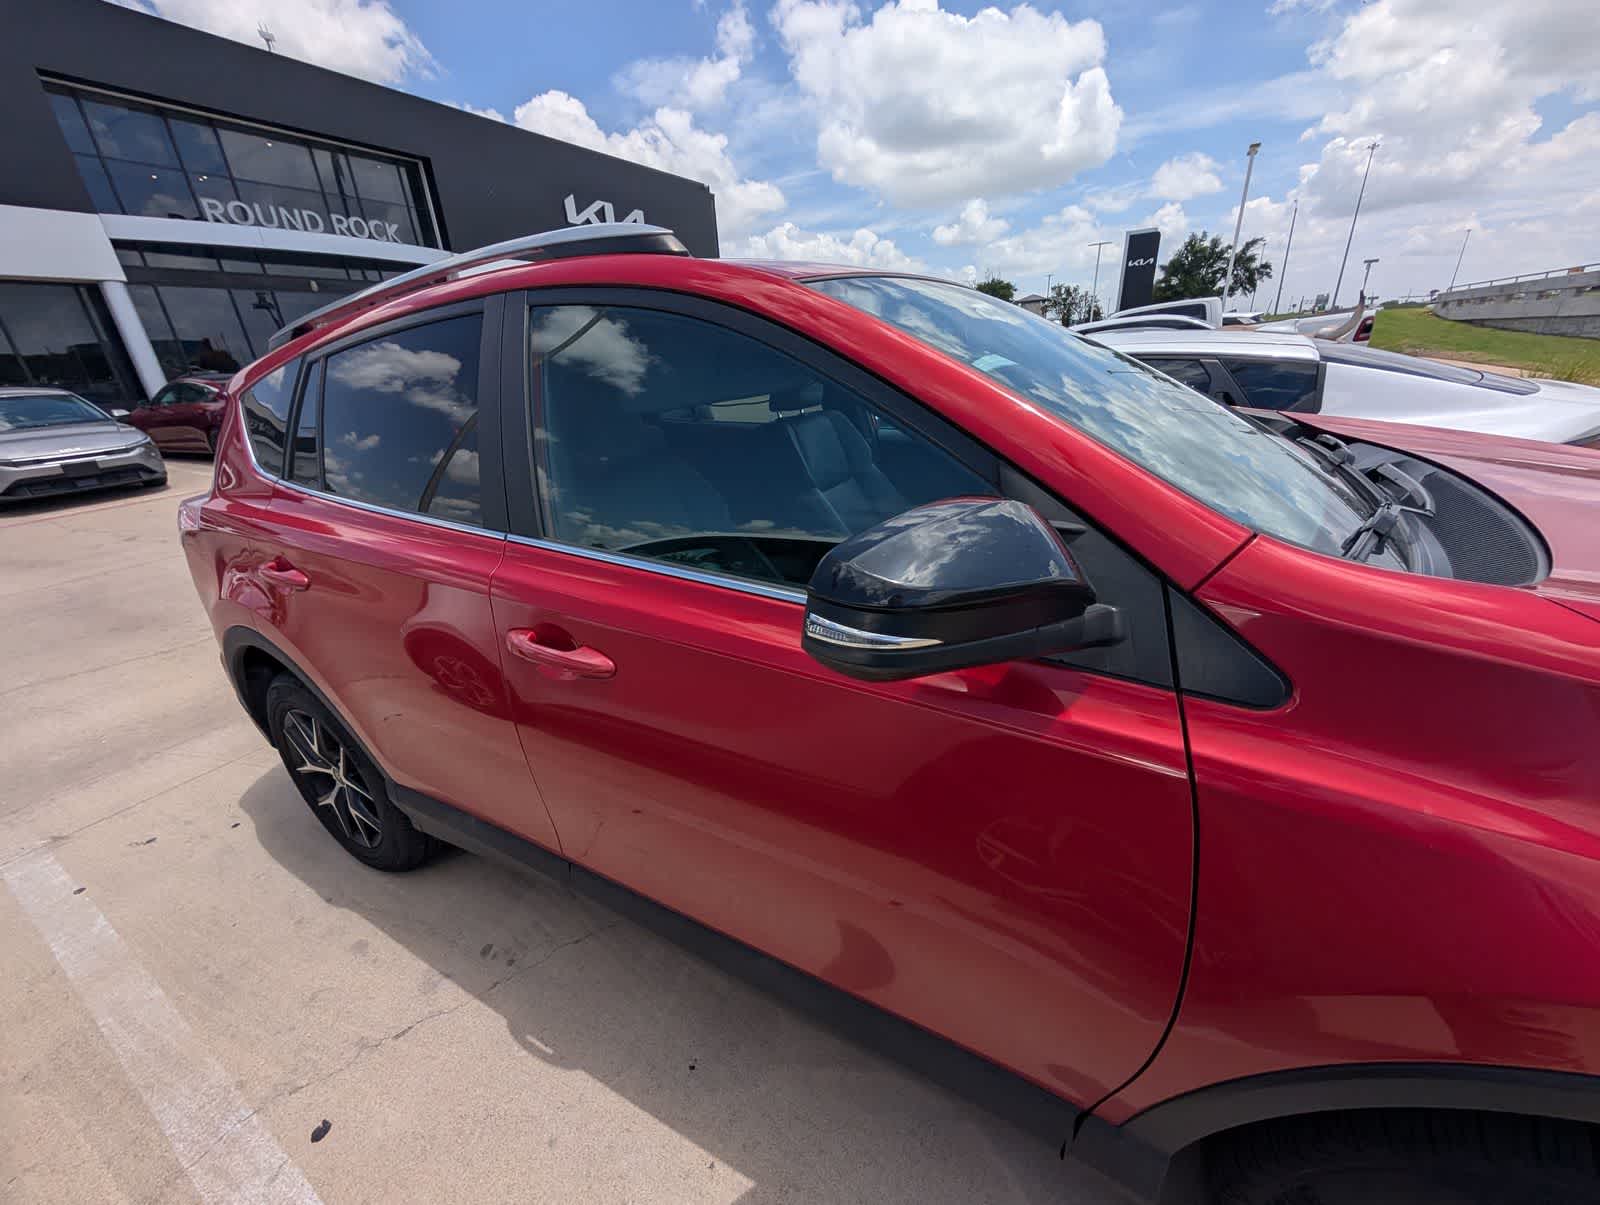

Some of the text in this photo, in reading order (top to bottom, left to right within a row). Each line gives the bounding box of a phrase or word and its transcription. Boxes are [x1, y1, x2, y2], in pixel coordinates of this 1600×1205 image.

[200, 198, 403, 243] ROUND ROCK
[1128, 257, 1155, 267] KIA
